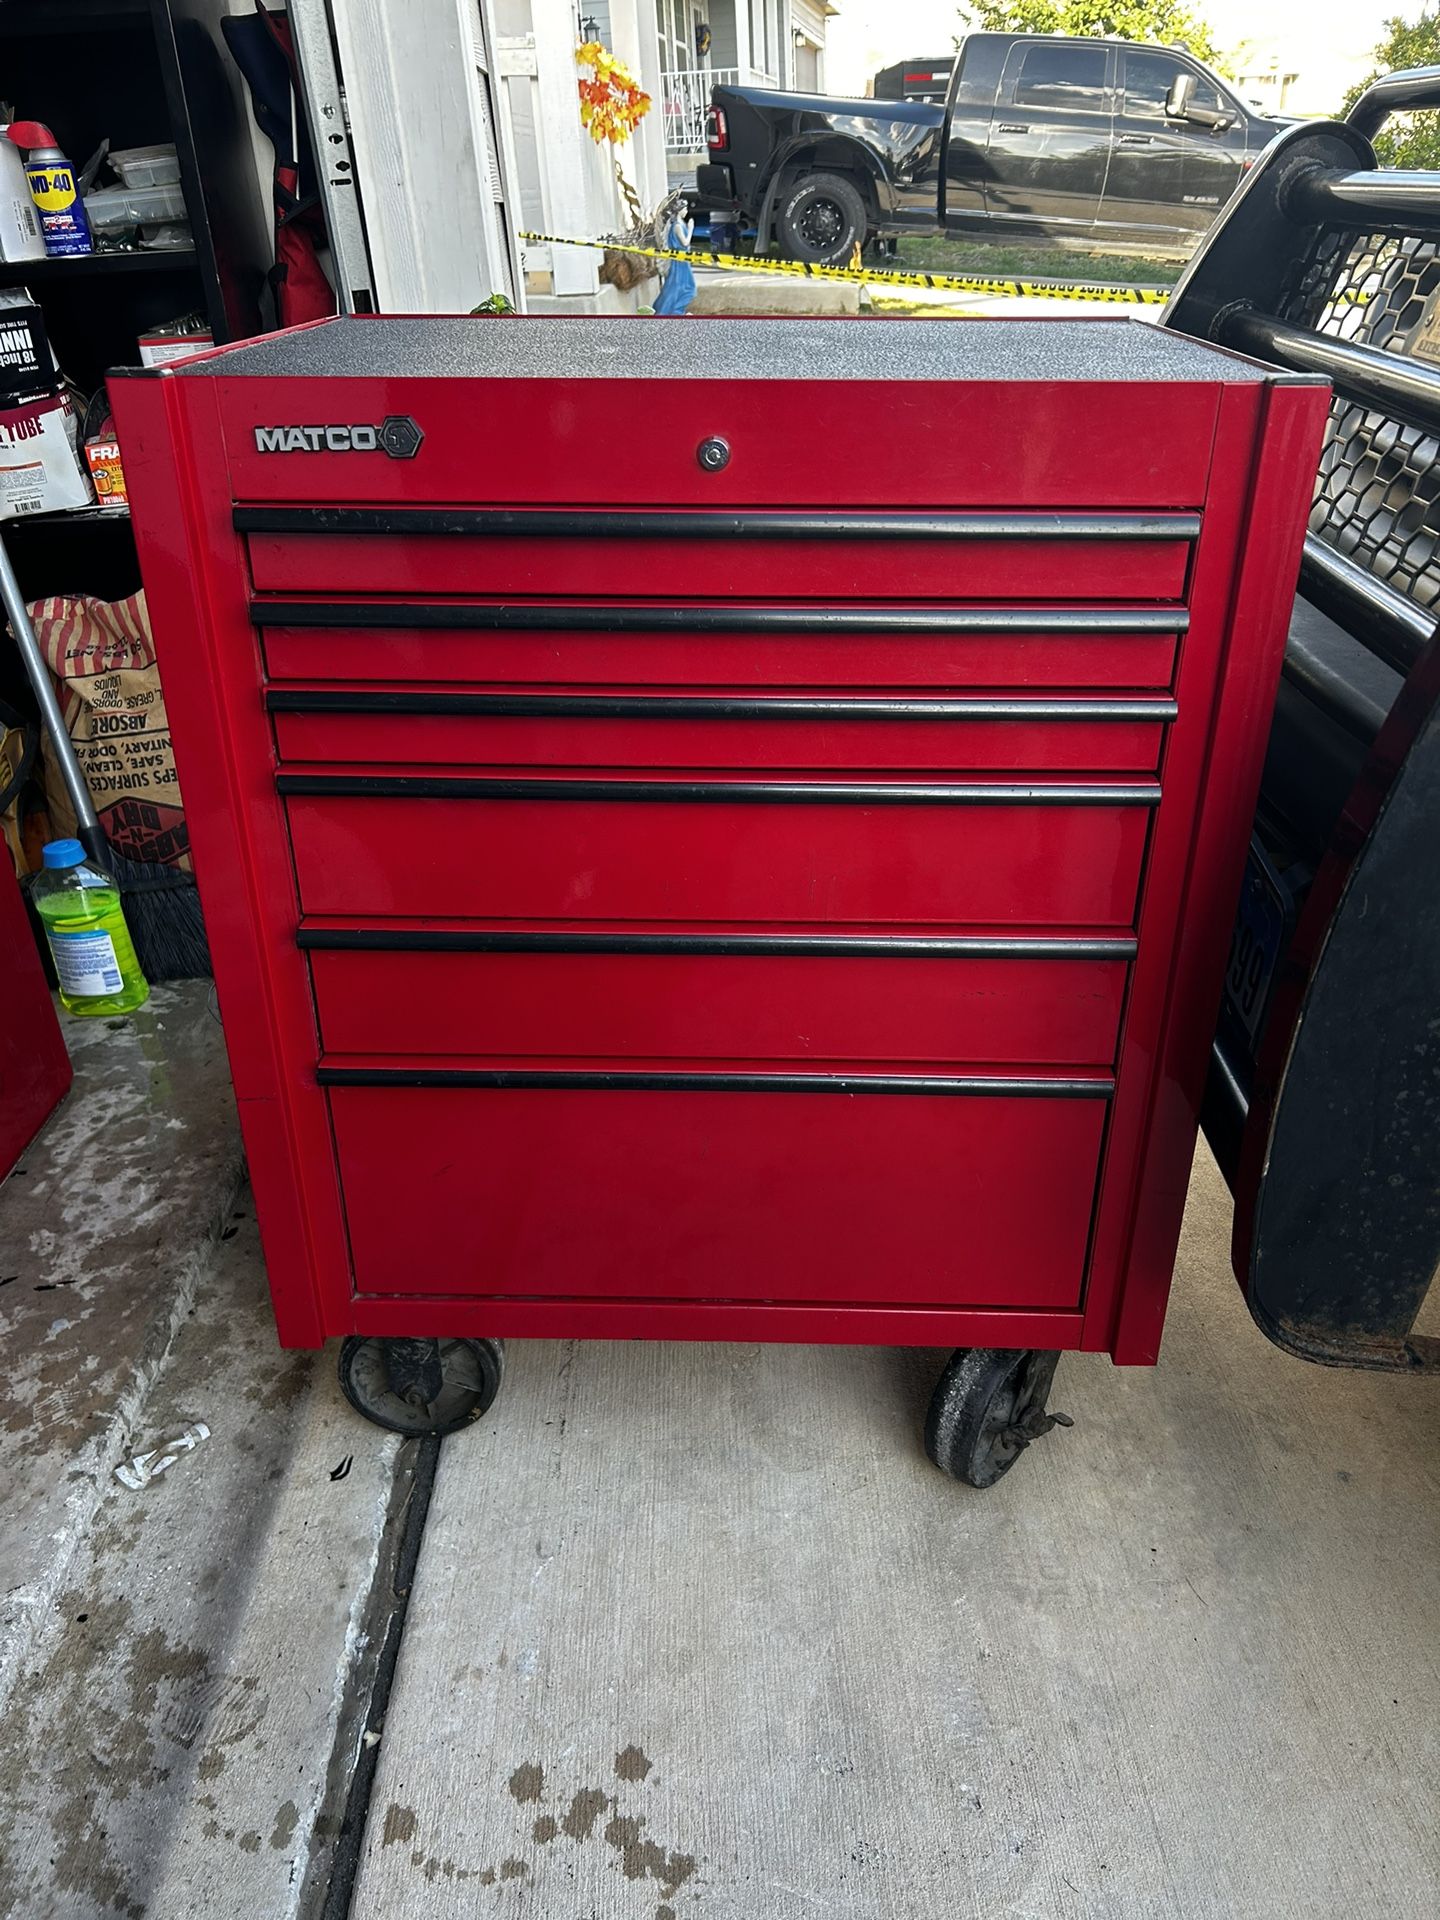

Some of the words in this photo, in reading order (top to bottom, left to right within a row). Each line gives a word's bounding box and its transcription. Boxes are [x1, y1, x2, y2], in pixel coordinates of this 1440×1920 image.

[29, 174, 72, 194] WD-40
[22, 350, 36, 363] 18
[4, 415, 45, 442] TUBE
[254, 426, 377, 451] MATCO
[94, 674, 122, 691] LIQUIDS
[101, 688, 119, 699] AND
[125, 690, 154, 709] GREASE,
[92, 697, 122, 709] ODORS,
[83, 760, 123, 773] CLEAN,
[126, 755, 164, 768] SAFE,
[90, 772, 150, 791] SURFACES
[111, 801, 162, 836] DRY
